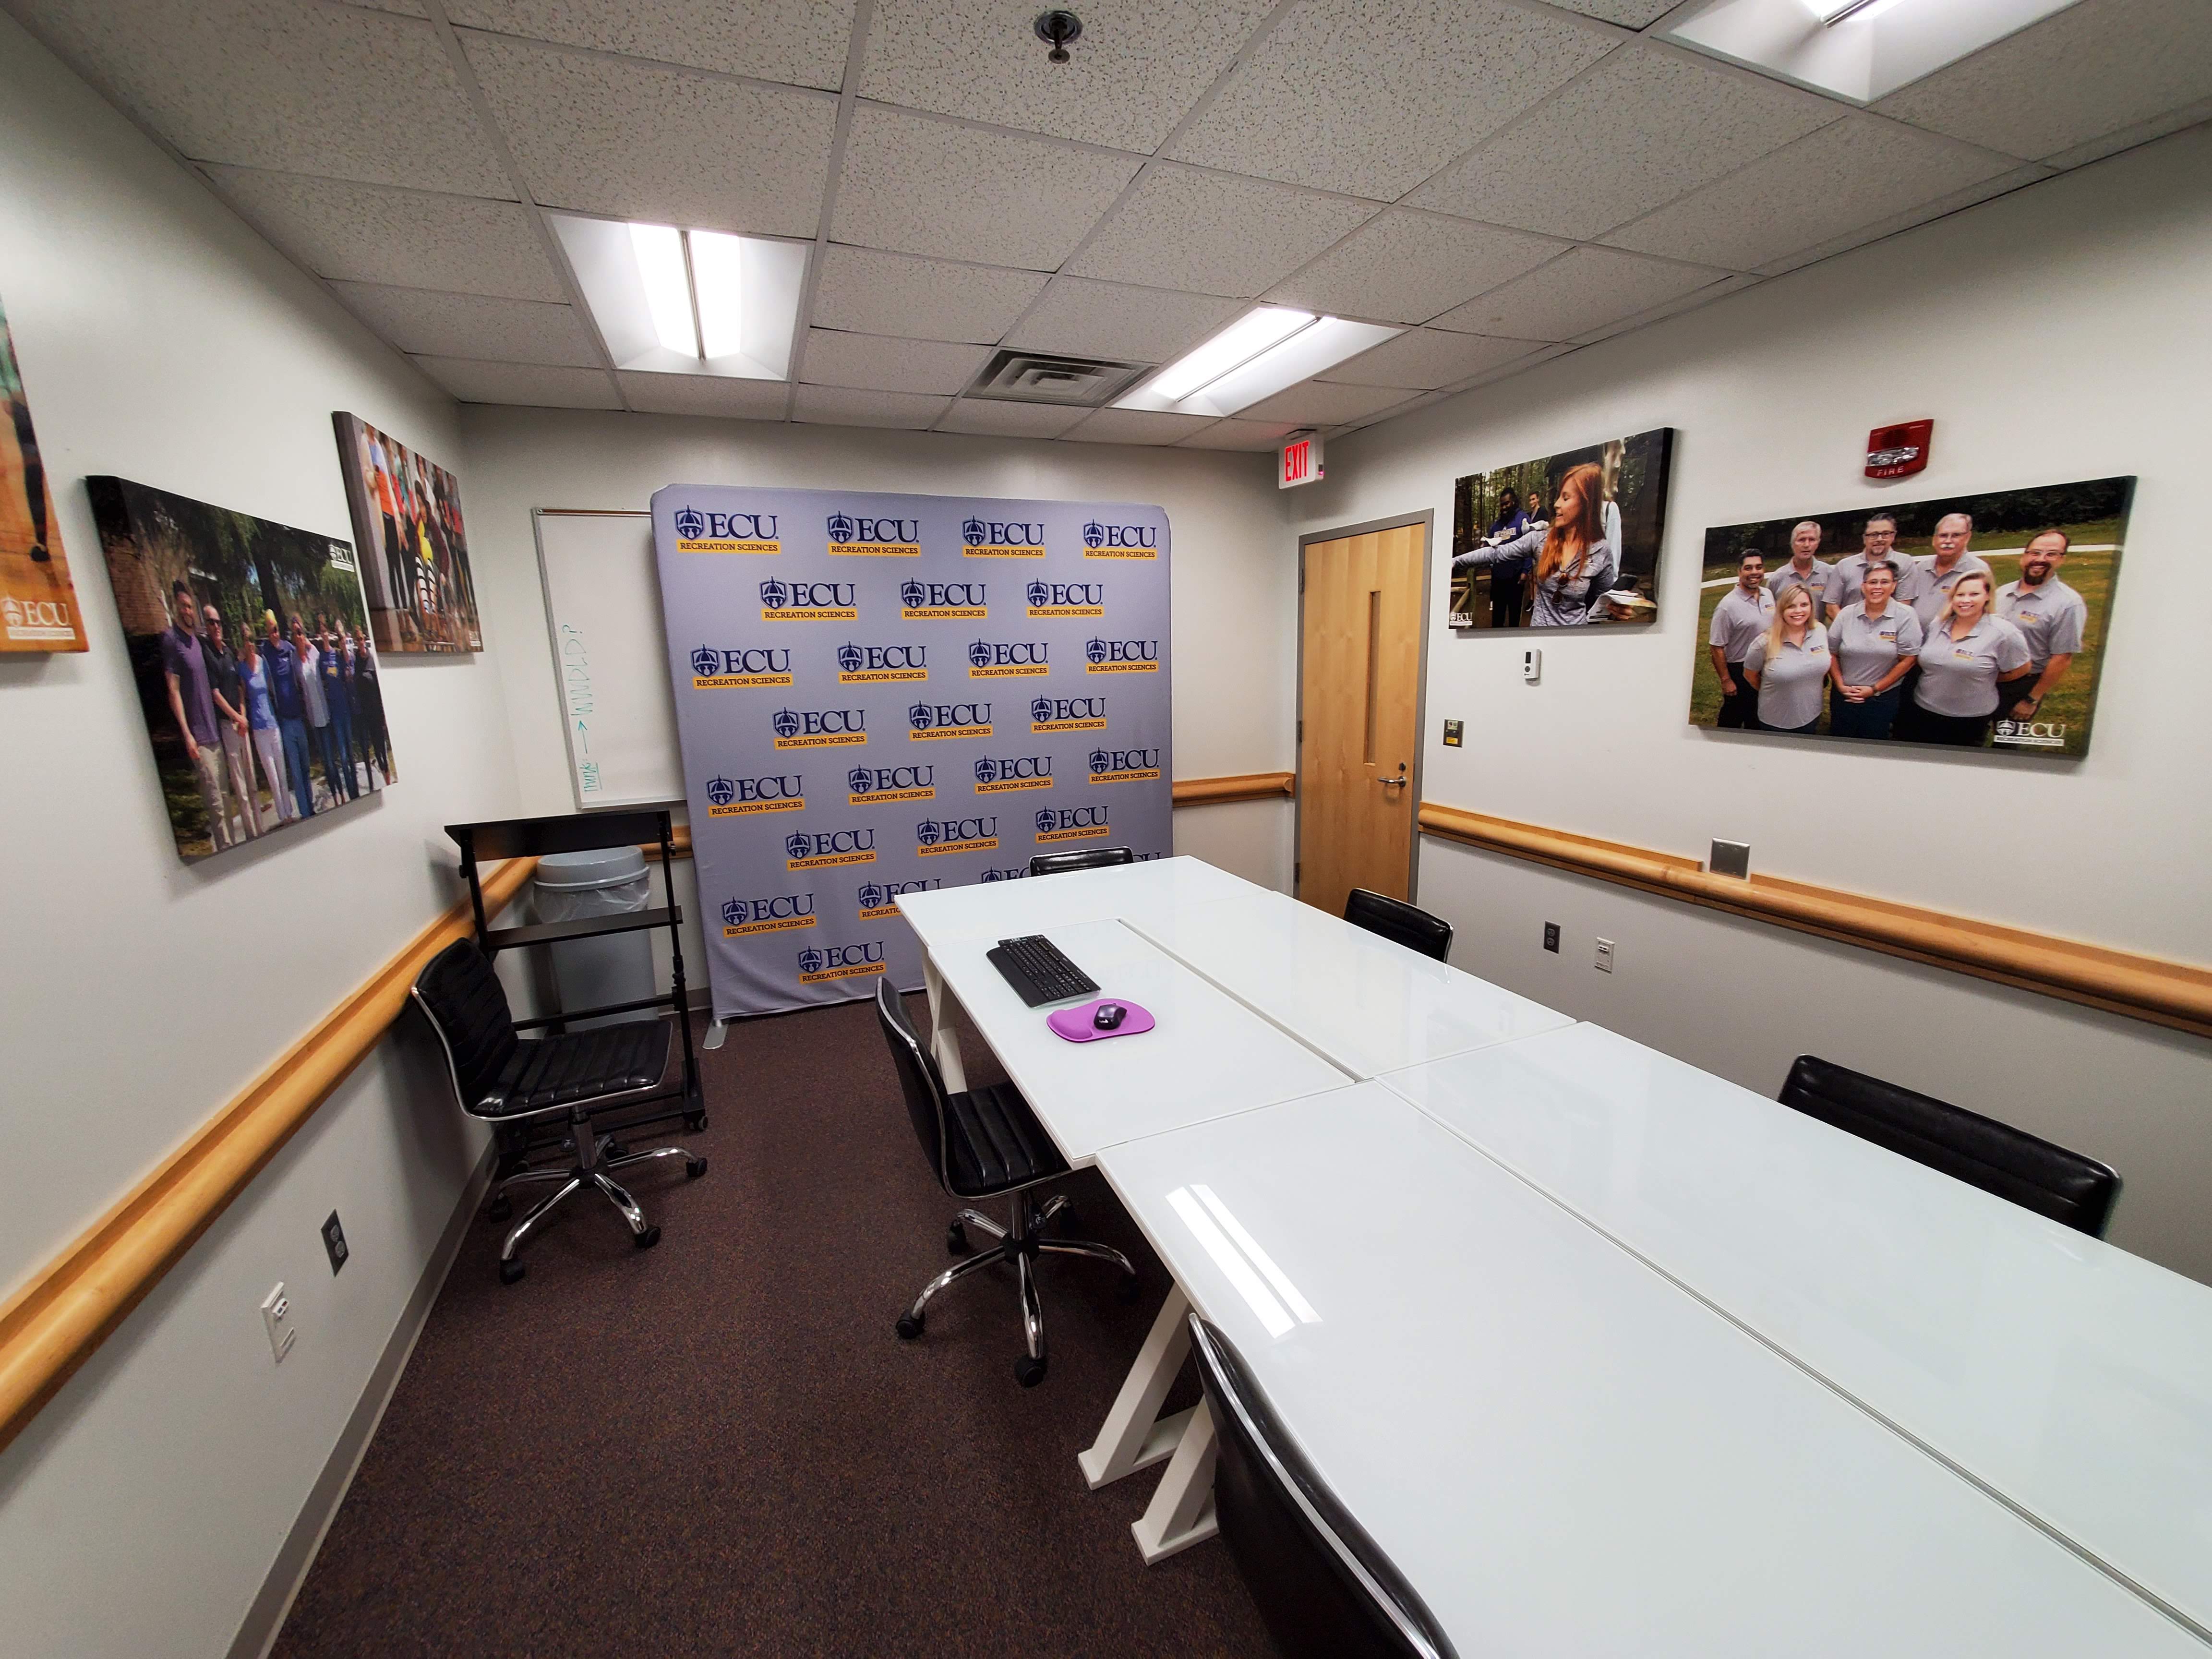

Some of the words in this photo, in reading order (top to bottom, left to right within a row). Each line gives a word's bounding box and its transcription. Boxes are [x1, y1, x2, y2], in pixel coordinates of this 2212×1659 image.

[1285, 441, 1310, 481] EXIT
[1877, 466, 1904, 476] FIRE
[706, 514, 777, 539] ECU
[855, 519, 919, 542] ECU
[987, 523, 1044, 545] ECU
[1106, 527, 1156, 547] ECU
[789, 584, 855, 606] ECU
[927, 584, 986, 606] ECU
[1050, 585, 1103, 605] ECU
[20, 601, 71, 626] ECU
[1456, 612, 1473, 621] ECU
[721, 649, 790, 673] ECU
[865, 647, 926, 669] ECU
[993, 644, 1048, 665] ECU
[1108, 641, 1158, 661] ECU
[696, 677, 750, 686] RECREATION
[751, 676, 791, 685] SCIENCES
[842, 673, 890, 681] RECREATION
[971, 668, 1014, 676] RECREATION
[934, 704, 992, 727] ECU
[1054, 698, 1106, 720] ECU
[801, 710, 865, 734] ECU
[1034, 722, 1074, 731] RECREATION
[2016, 722, 2066, 738] ECU
[777, 738, 827, 747] RECREATION
[828, 736, 865, 744] SCIENCES
[912, 730, 957, 739] RECREATION
[958, 728, 991, 736] SCIENCES
[998, 757, 1052, 780] ECU
[1111, 749, 1159, 770] ECU
[874, 766, 934, 790] ECU
[977, 782, 1019, 792] RECREATION
[1020, 780, 1051, 788] SCIENCES
[1091, 773, 1130, 782] RECREATION
[736, 776, 802, 801] ECU
[852, 793, 898, 803] RECREATION
[899, 790, 933, 799] SCIENCES
[711, 804, 763, 815] RECREATION
[764, 801, 803, 810] SCIENCES
[1058, 806, 1108, 829] ECU
[941, 817, 997, 842] ECU
[1038, 831, 1077, 841] RECREATION
[1078, 828, 1107, 837] SCIENCES
[813, 830, 874, 855] ECU
[920, 844, 963, 854] RECREATION
[964, 840, 997, 849] SCIENCES
[790, 857, 838, 868] RECREATION
[839, 854, 875, 863] SCIENCES
[749, 894, 814, 921] ECU
[862, 907, 901, 917] RECREATIO
[726, 923, 776, 935] RECREATION
[777, 918, 814, 928] SCIENCES
[824, 942, 883, 968] ECU
[802, 970, 848, 982] RECREATION
[849, 964, 884, 974] SCIENCES
